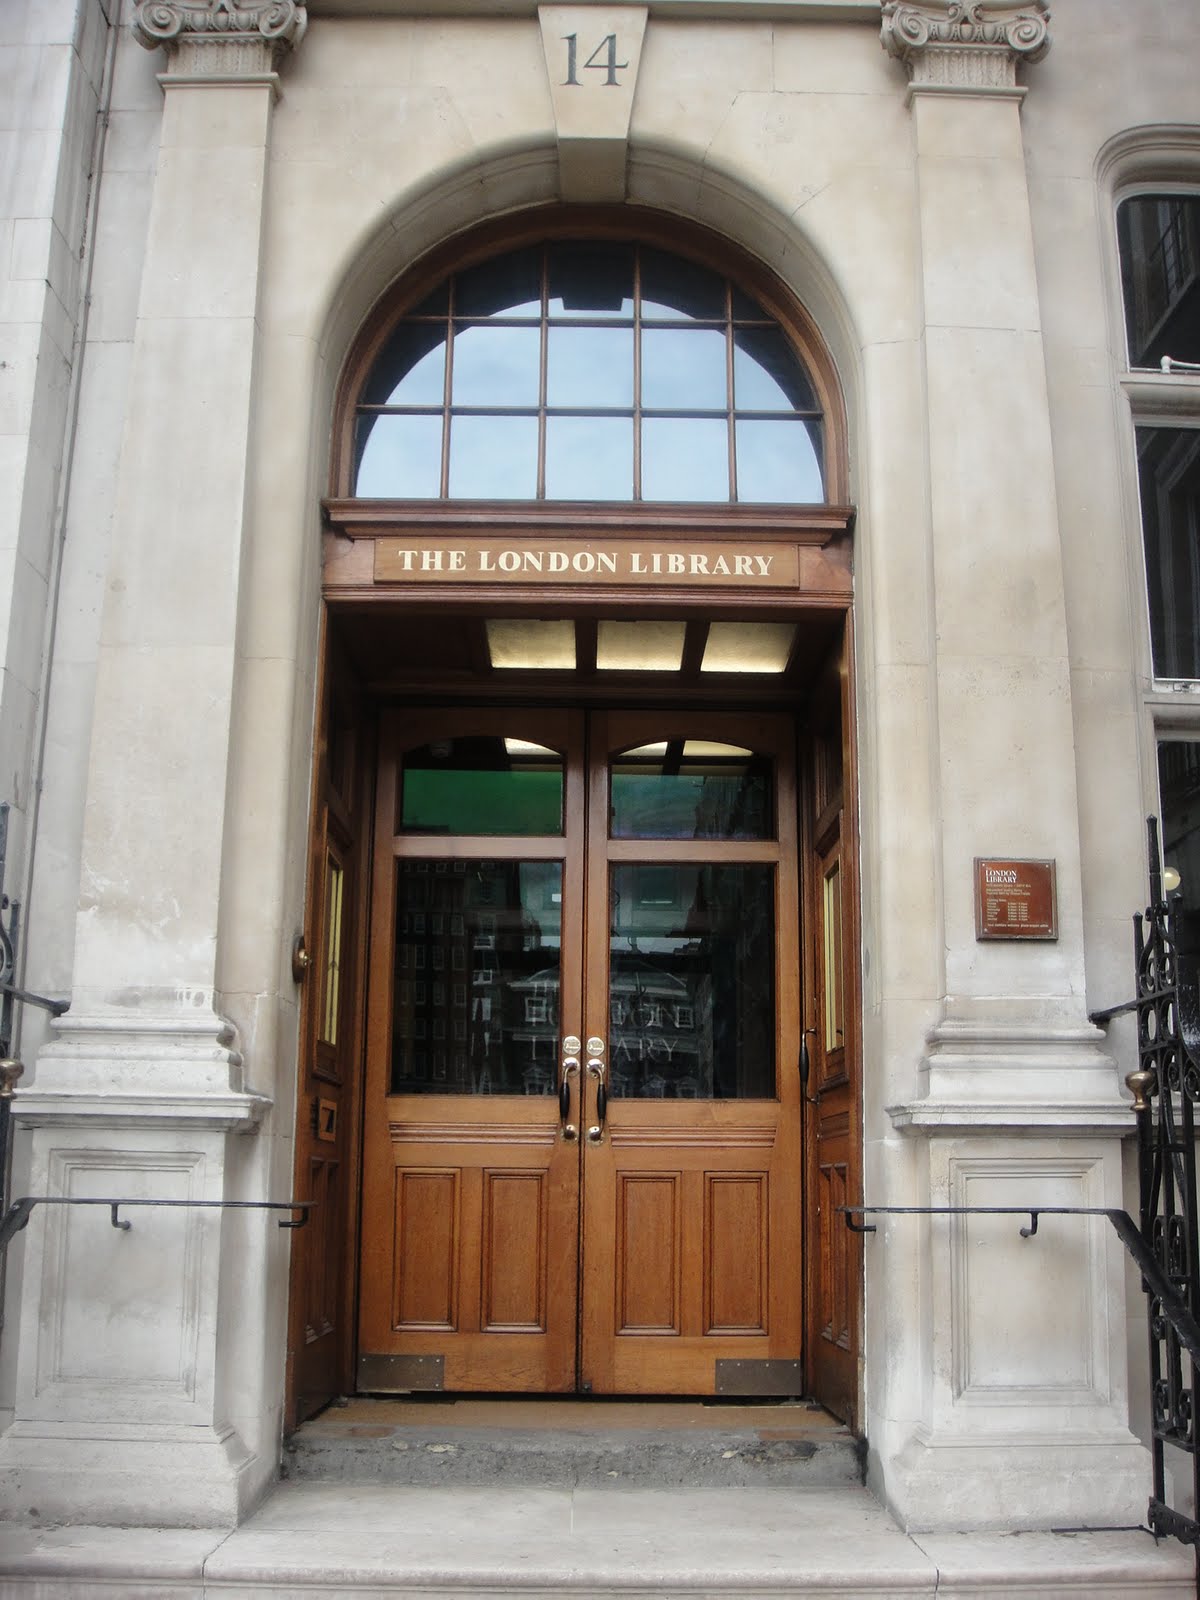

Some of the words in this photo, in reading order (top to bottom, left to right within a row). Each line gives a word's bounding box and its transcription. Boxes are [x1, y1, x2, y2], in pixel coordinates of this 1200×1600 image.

[559, 32, 629, 87] 14
[398, 550, 466, 572] THE
[478, 550, 618, 574] LONDON
[630, 552, 774, 577] LIBRARY
